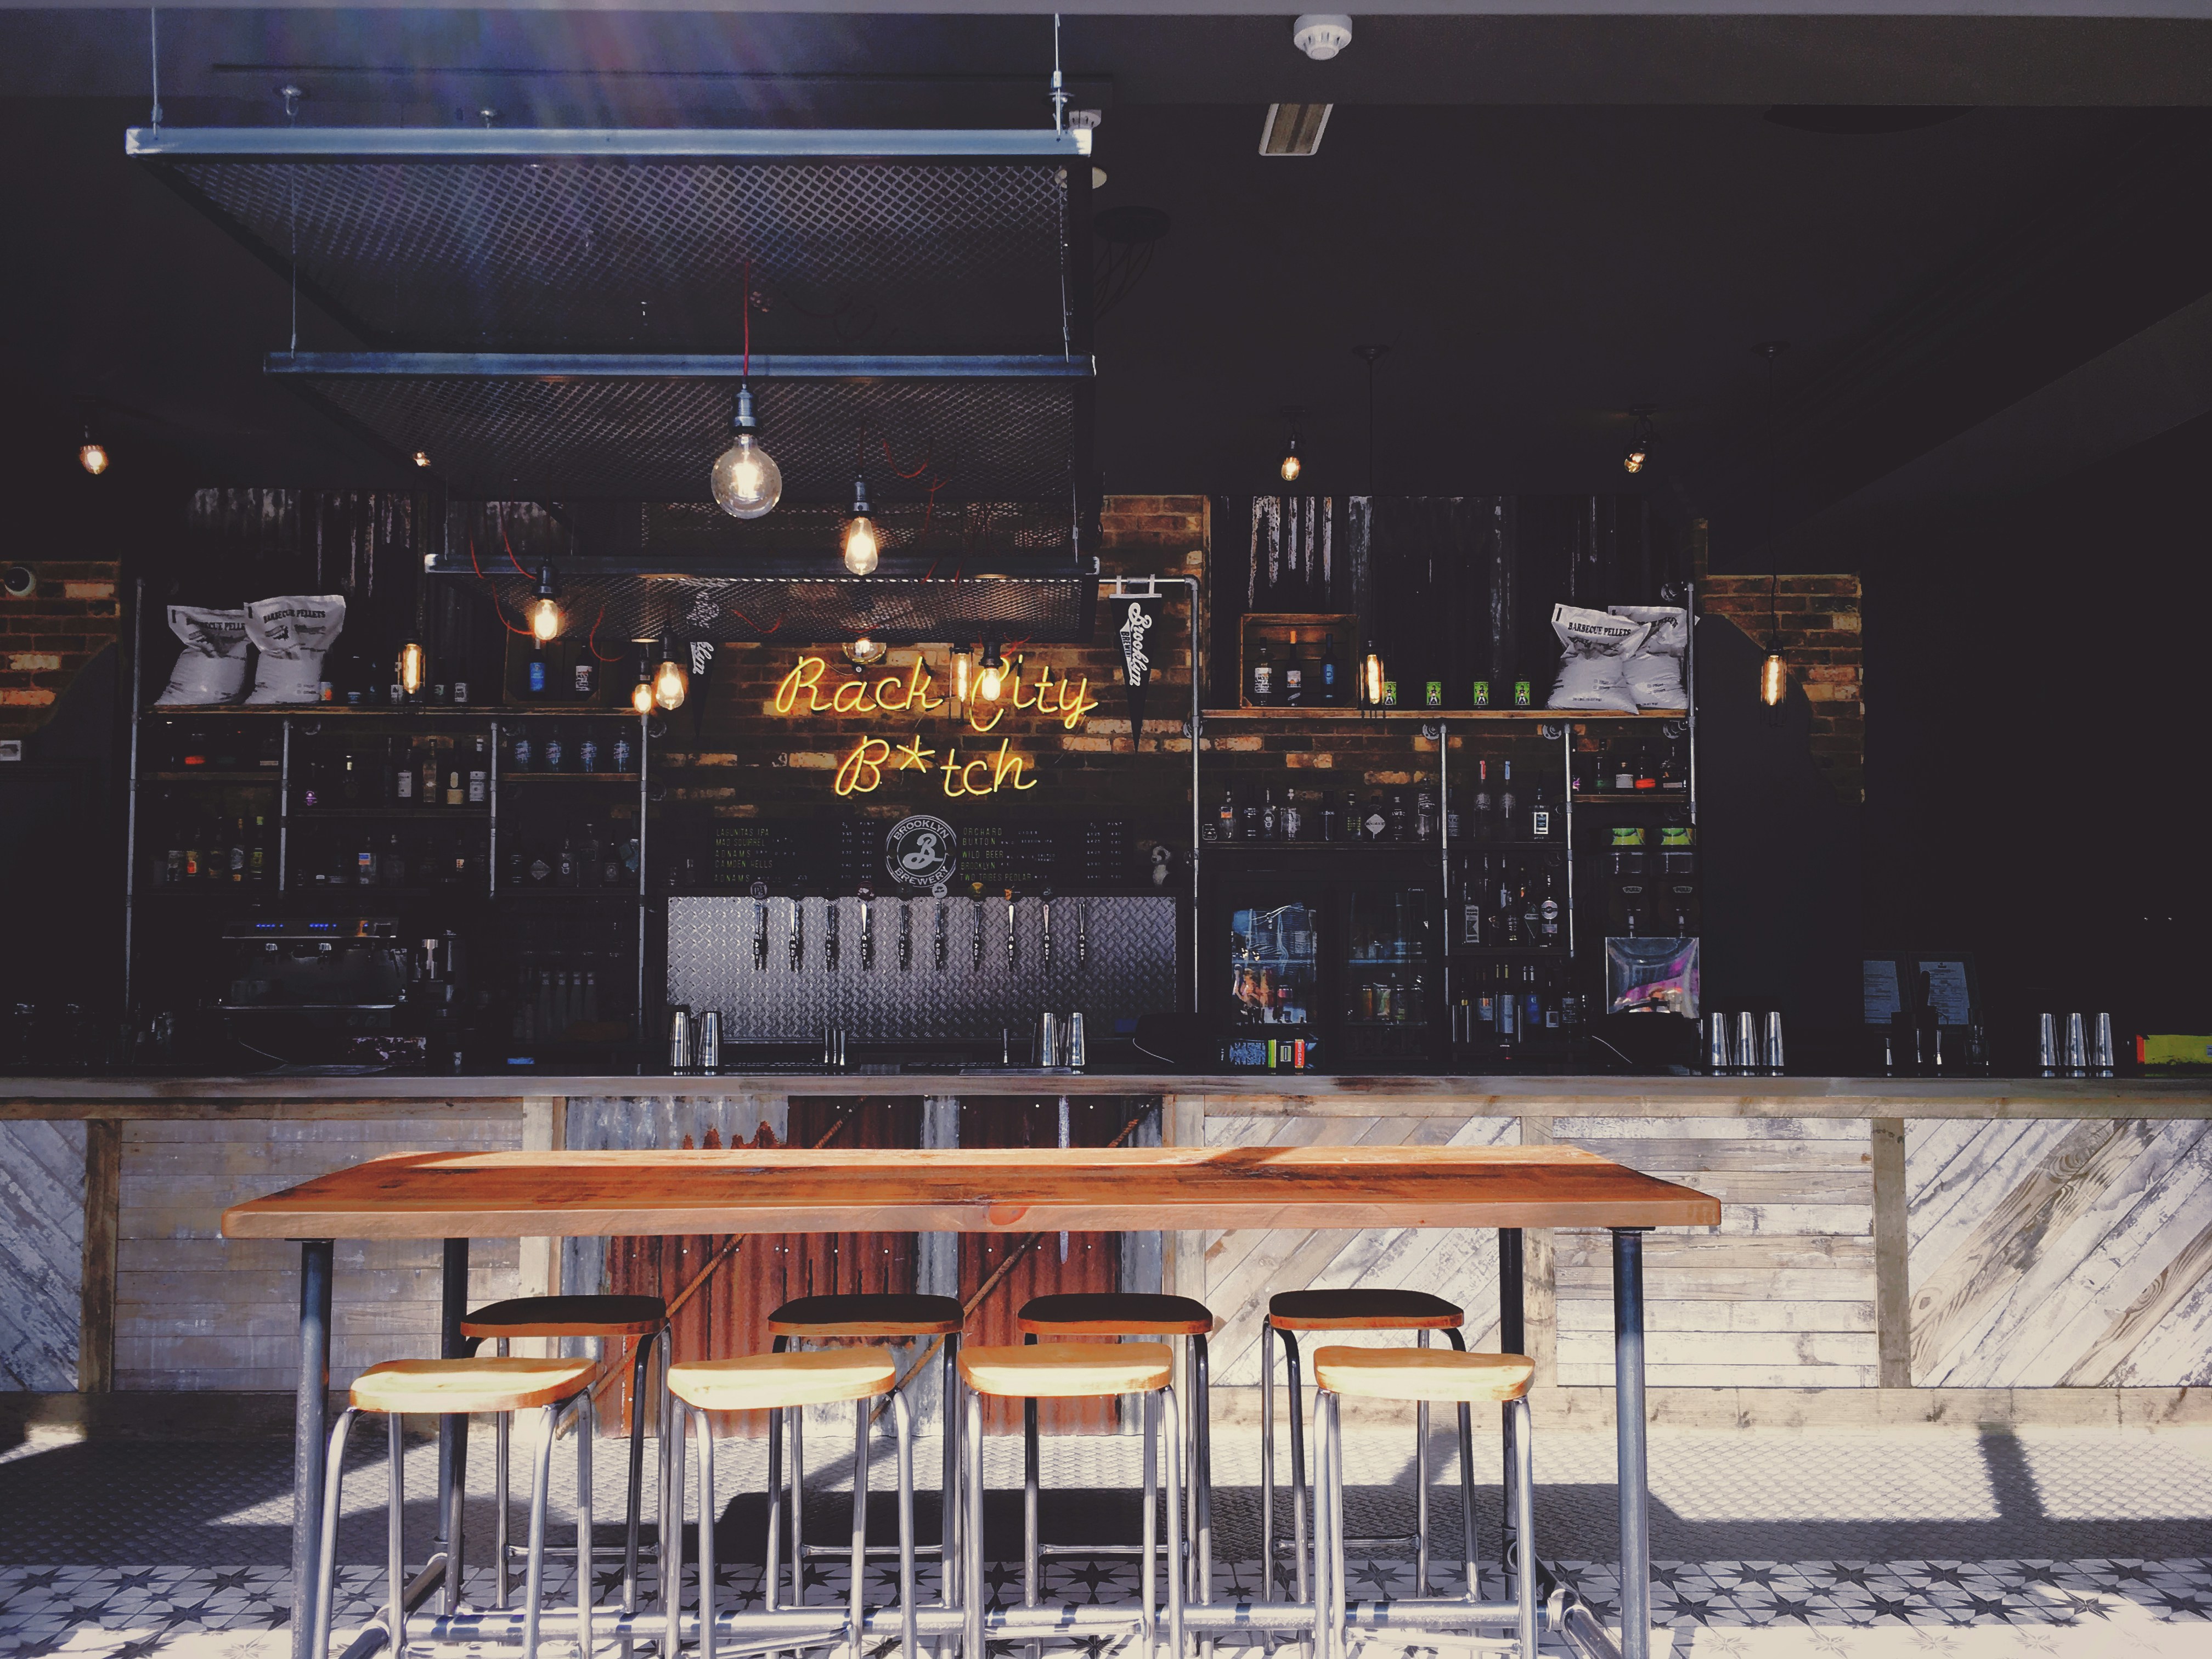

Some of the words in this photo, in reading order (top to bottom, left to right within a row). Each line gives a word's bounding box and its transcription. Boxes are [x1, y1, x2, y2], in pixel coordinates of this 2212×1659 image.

[296, 609, 326, 619] PELLETS
[1567, 622, 1603, 635] BARBECUE
[1604, 627, 1632, 637] PELLETS
[1128, 602, 1152, 686] Brooklyn
[775, 656, 944, 713] Rack
[970, 653, 1099, 732] City
[757, 828, 769, 836] IPA
[893, 820, 950, 840] BROOKLYN
[963, 827, 1002, 836] ORCHARD
[961, 862, 996, 870] BROOKLYN
[894, 866, 949, 885] BREWERY
